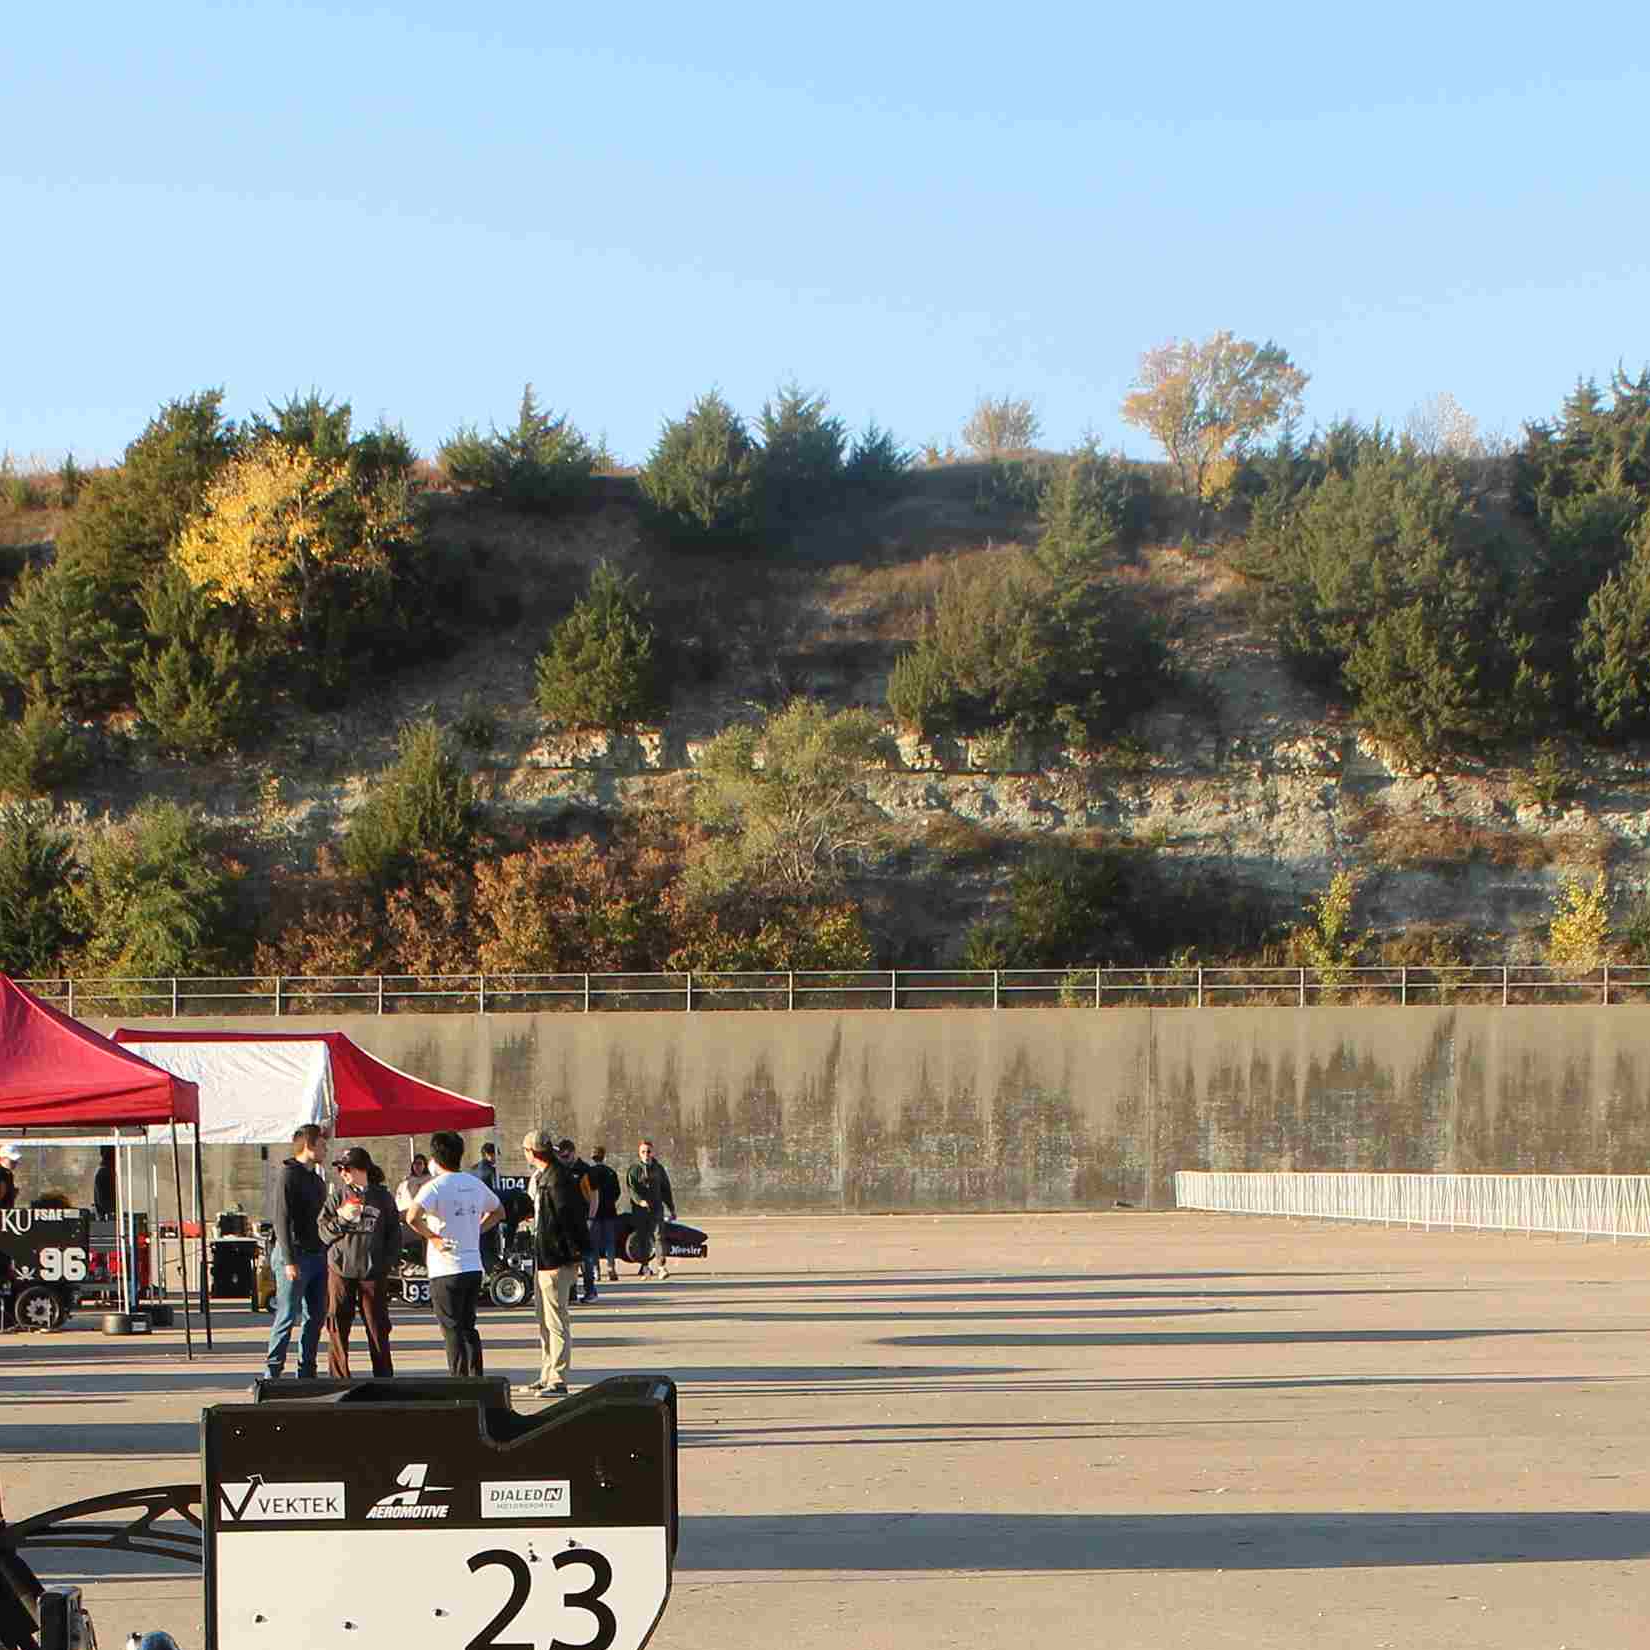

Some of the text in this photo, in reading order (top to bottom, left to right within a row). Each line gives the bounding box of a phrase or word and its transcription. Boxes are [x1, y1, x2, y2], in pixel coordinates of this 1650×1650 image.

[0, 1208, 32, 1236] KU
[34, 1208, 63, 1221] FSAE
[39, 1247, 87, 1281] 96
[259, 1497, 339, 1514] VEKTEK
[366, 1504, 450, 1519] AEROMOTIVE
